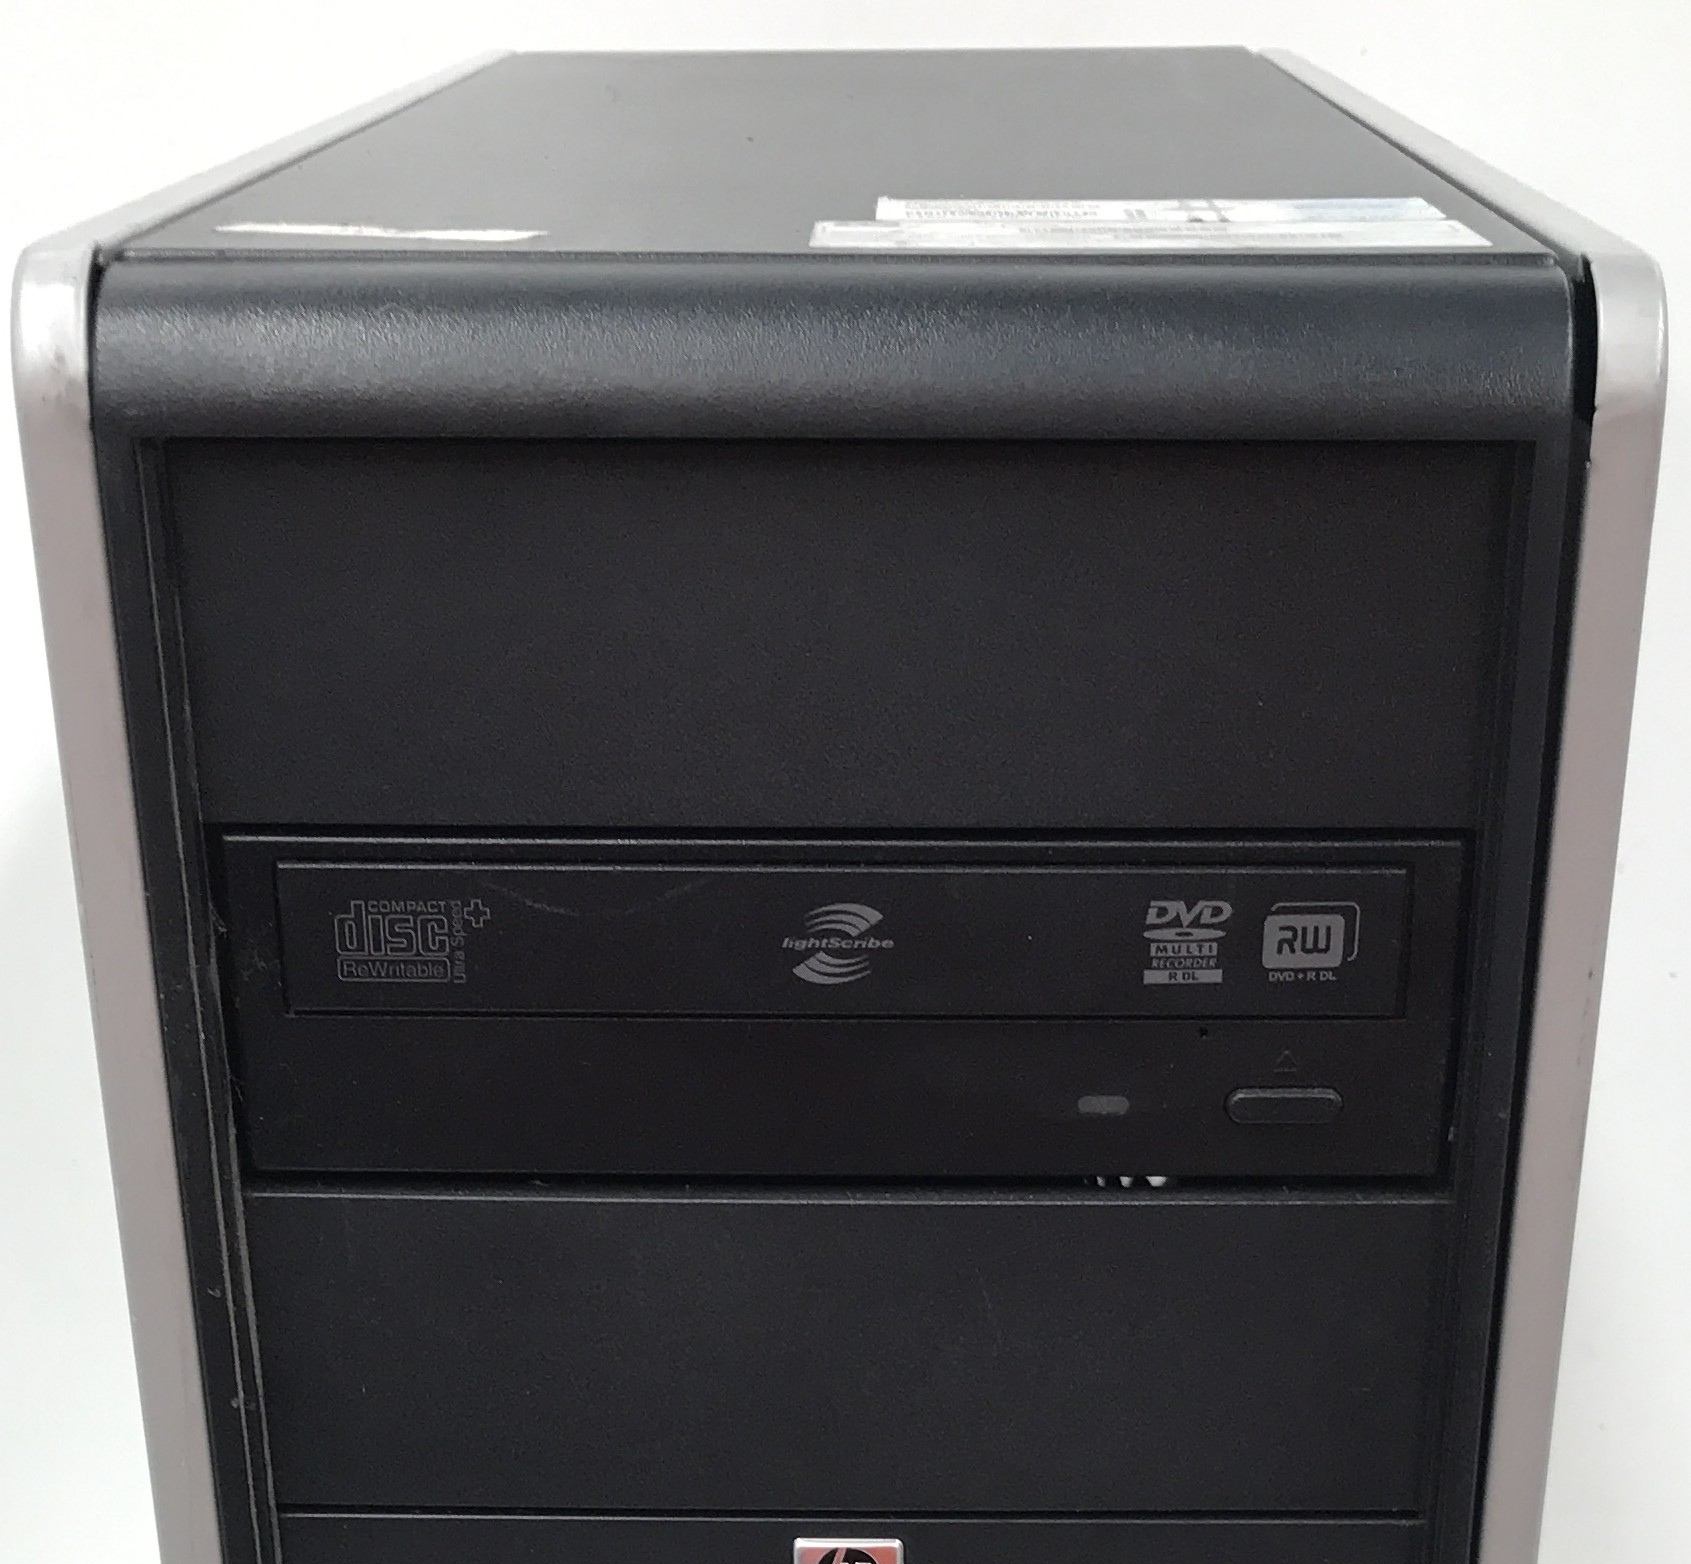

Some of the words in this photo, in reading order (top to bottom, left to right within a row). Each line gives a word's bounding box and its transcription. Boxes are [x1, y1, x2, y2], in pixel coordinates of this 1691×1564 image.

[368, 901, 446, 913] COMPACT
[1145, 901, 1232, 928] DVD
[334, 900, 449, 956] disc
[449, 901, 467, 946] Speed
[1276, 925, 1331, 955] RW
[1155, 944, 1213, 955] MULTI
[343, 961, 444, 977] ReWritable
[453, 951, 466, 983] Ultra
[1151, 957, 1217, 968] RECORDER
[1182, 971, 1199, 981] DL
[1320, 970, 1337, 980] DL
